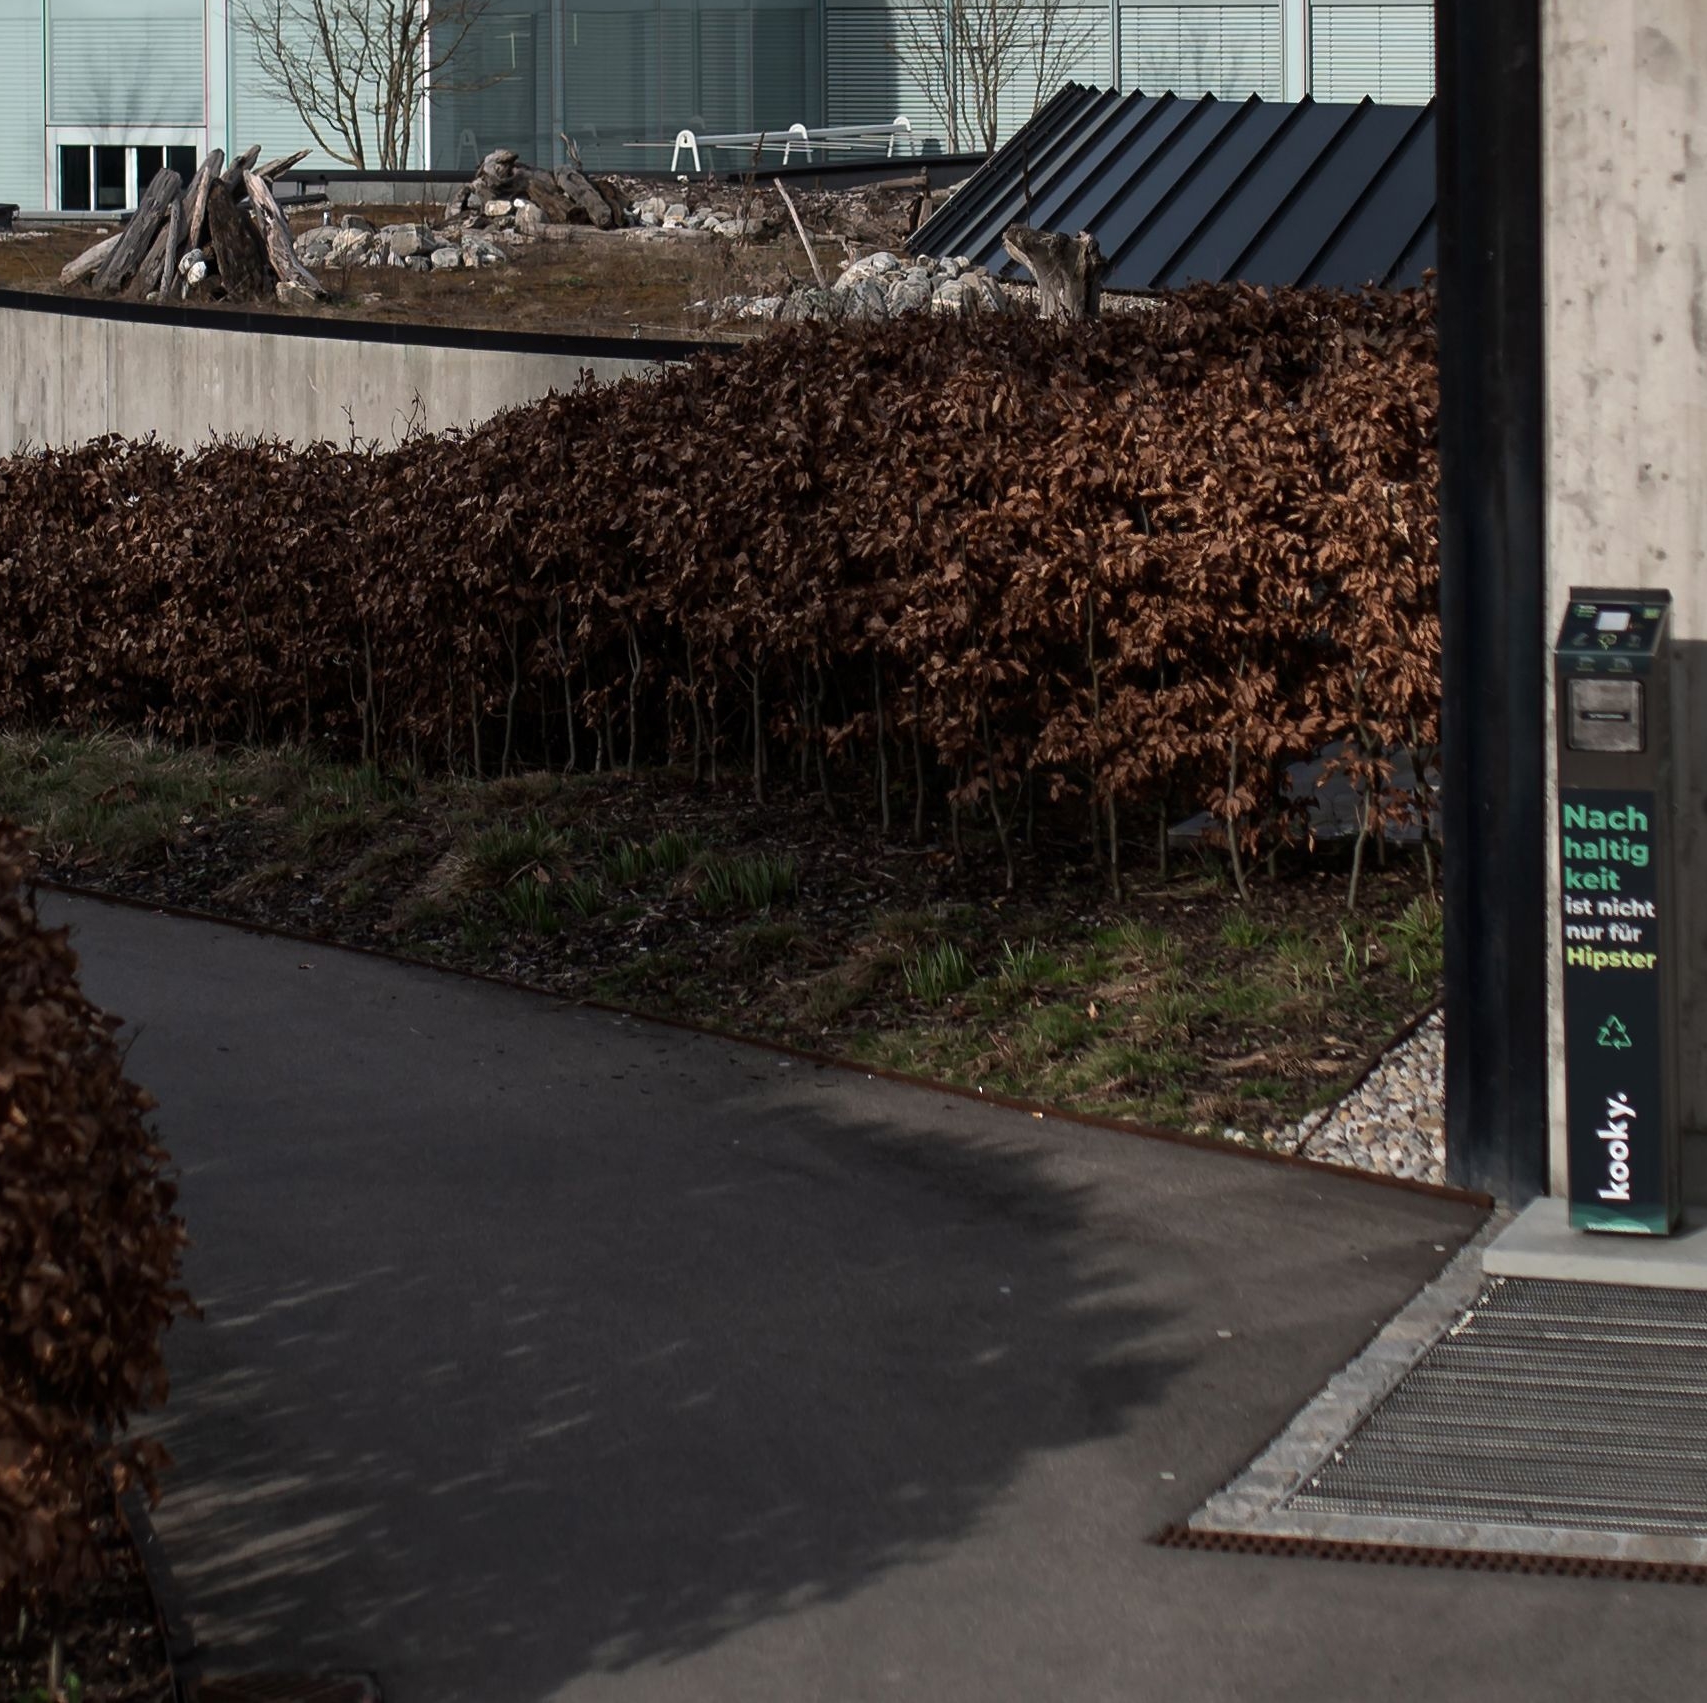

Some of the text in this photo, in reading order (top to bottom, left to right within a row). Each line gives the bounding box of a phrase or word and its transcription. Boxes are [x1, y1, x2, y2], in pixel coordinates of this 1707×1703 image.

[1563, 803, 1649, 832] Nach
[1563, 836, 1650, 867] haltig
[1564, 866, 1622, 891] keit
[1564, 894, 1657, 918] ist nicht
[1565, 922, 1643, 944] nur für
[1565, 944, 1658, 972] Hipster
